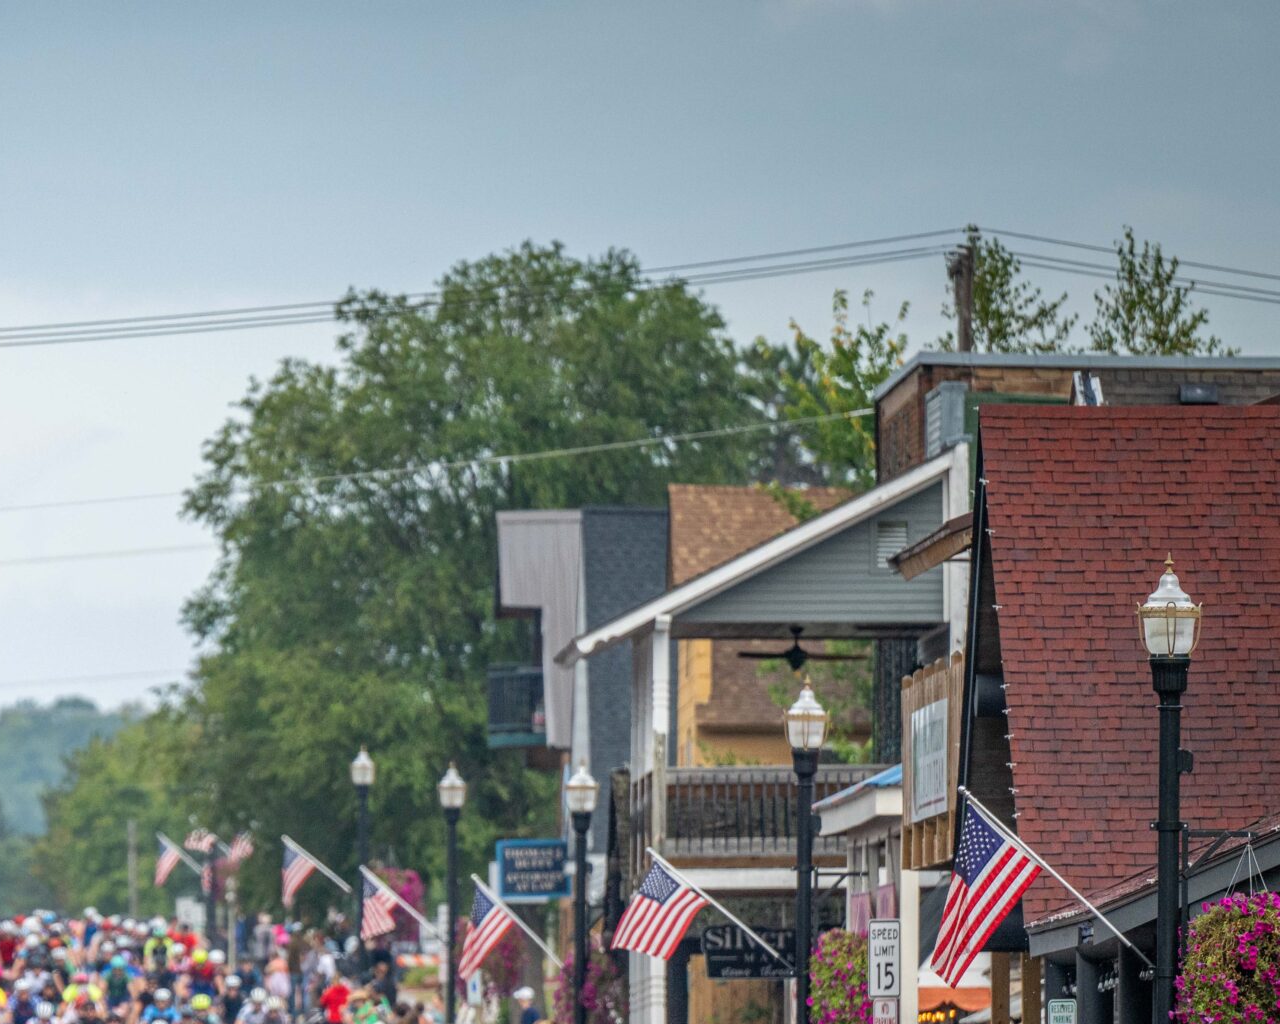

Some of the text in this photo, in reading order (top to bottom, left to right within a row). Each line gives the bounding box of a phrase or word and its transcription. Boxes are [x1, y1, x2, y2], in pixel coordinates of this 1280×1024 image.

[871, 928, 898, 940] SPEED
[874, 945, 895, 956] LIMIT
[876, 962, 895, 990] 15
[1051, 1005, 1073, 1013] RESERVED
[1053, 1015, 1072, 1023] PARKING
